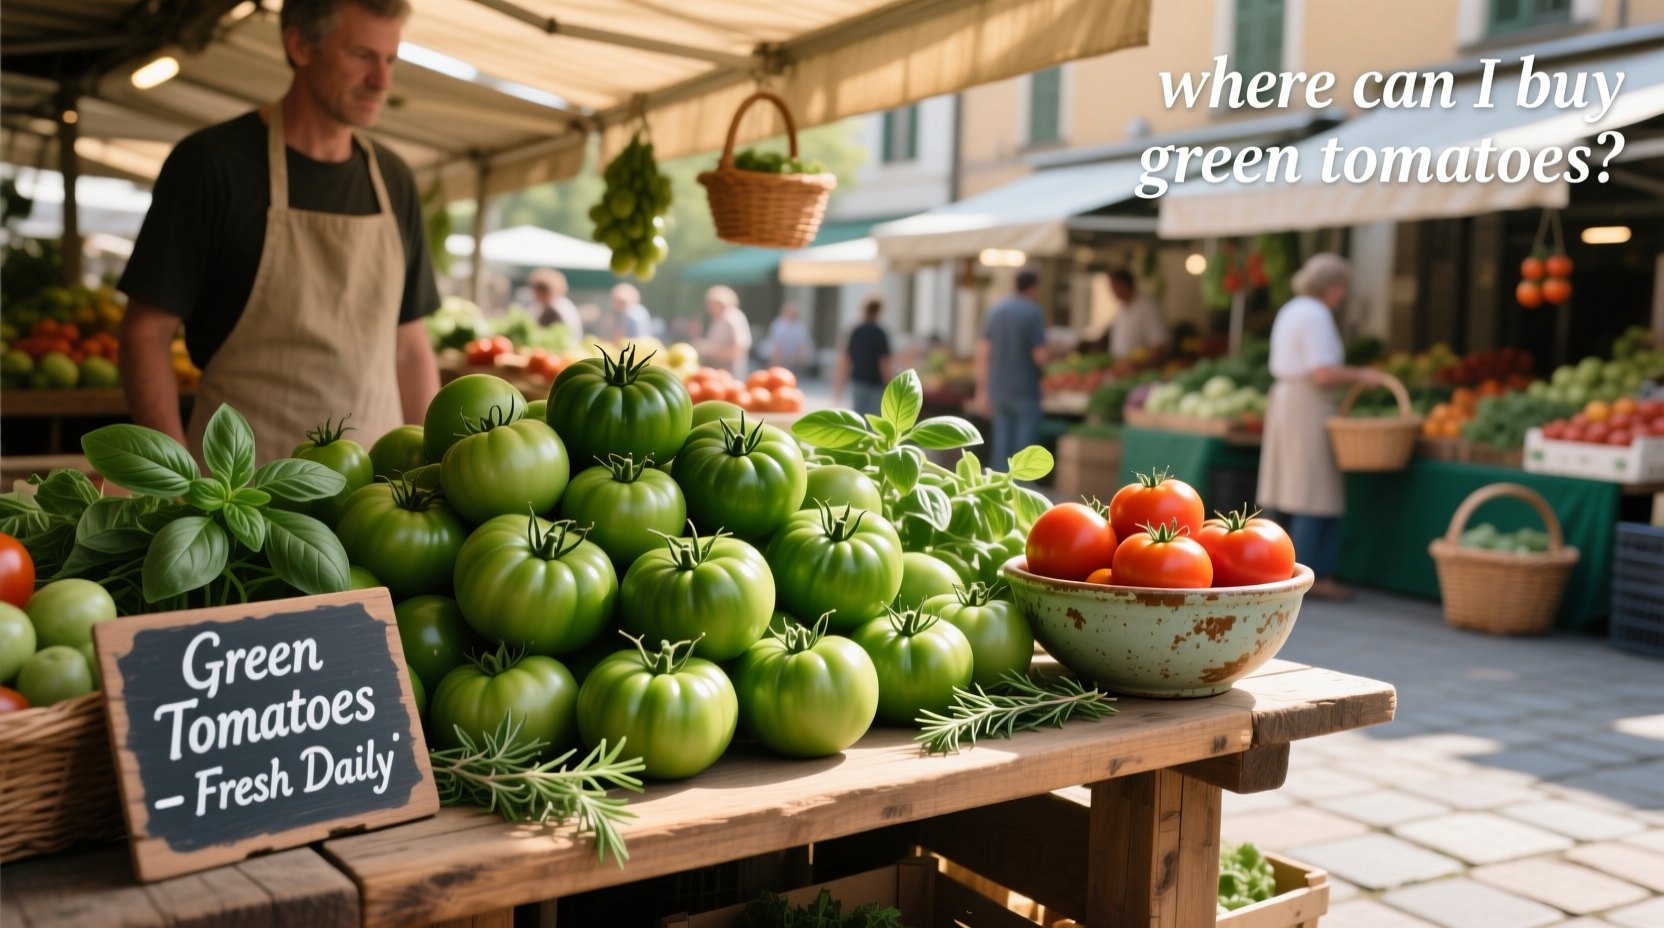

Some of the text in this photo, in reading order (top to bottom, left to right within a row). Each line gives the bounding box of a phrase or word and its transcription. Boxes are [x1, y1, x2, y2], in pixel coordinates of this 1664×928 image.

[182, 630, 324, 699] Green
[153, 685, 376, 761] Tomatoes
[194, 756, 294, 817] Fresh
